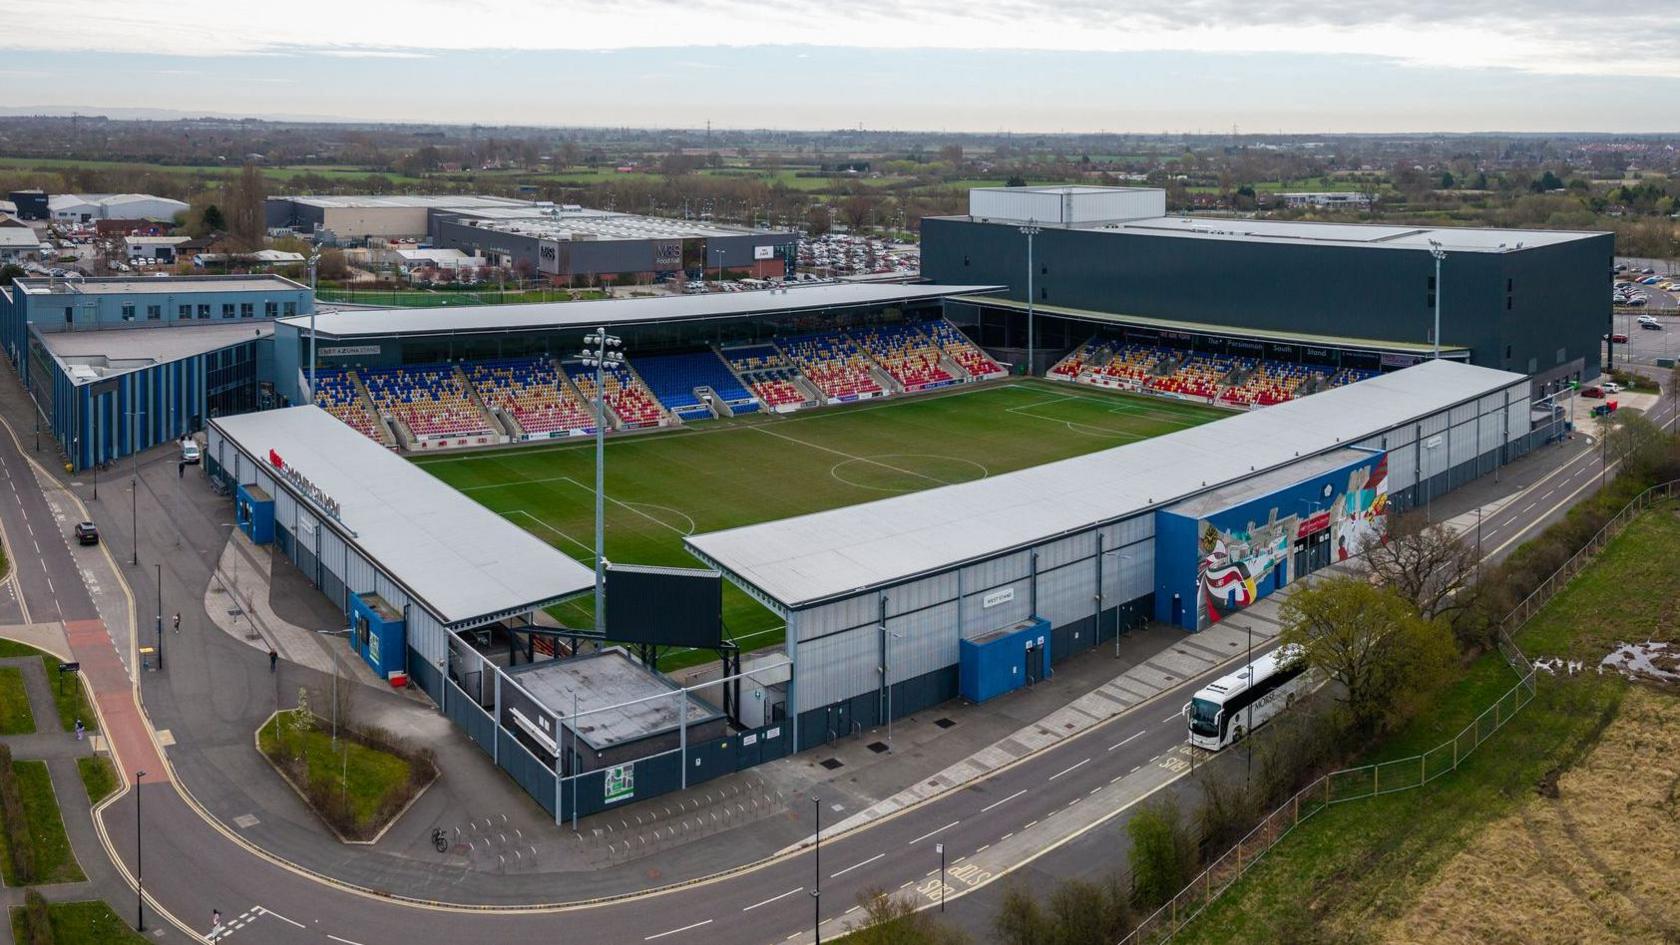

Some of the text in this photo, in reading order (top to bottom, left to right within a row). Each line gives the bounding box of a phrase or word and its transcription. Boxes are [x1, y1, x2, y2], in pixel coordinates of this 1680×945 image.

[656, 243, 680, 257] M&S
[1227, 340, 1263, 351] Persimmon
[1273, 344, 1292, 353] South
[1306, 348, 1327, 357] Stand
[947, 864, 992, 886] STOP
[916, 879, 955, 902] BUS
